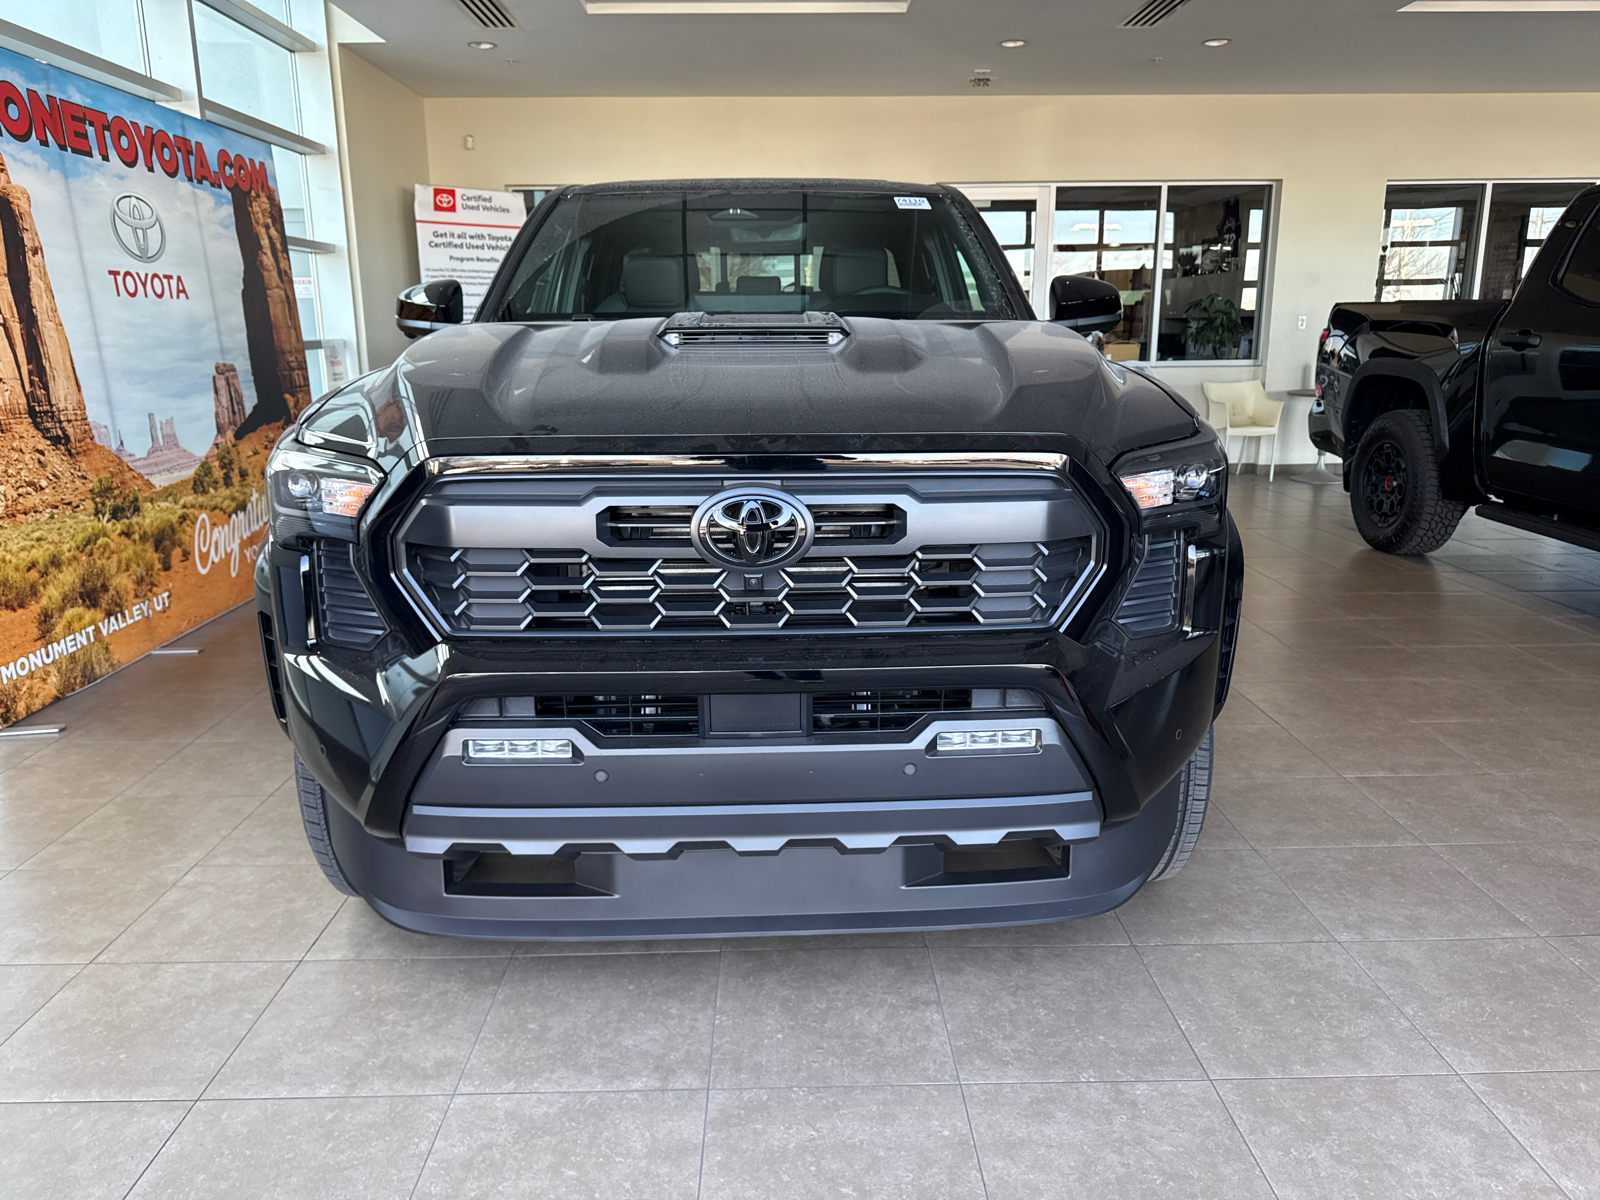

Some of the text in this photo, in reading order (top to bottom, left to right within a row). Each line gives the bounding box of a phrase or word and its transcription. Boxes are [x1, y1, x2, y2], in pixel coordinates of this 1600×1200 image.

[461, 193, 492, 203] Certified
[461, 203, 510, 213] Used Vehicles
[432, 230, 512, 243] Get it all with Toyota
[428, 240, 463, 250] Certified
[465, 242, 485, 250] Used
[449, 255, 475, 263] Program
[107, 269, 190, 300] TOYOTA
[0, 591, 170, 685] MONUMENT VALLEY, UT
